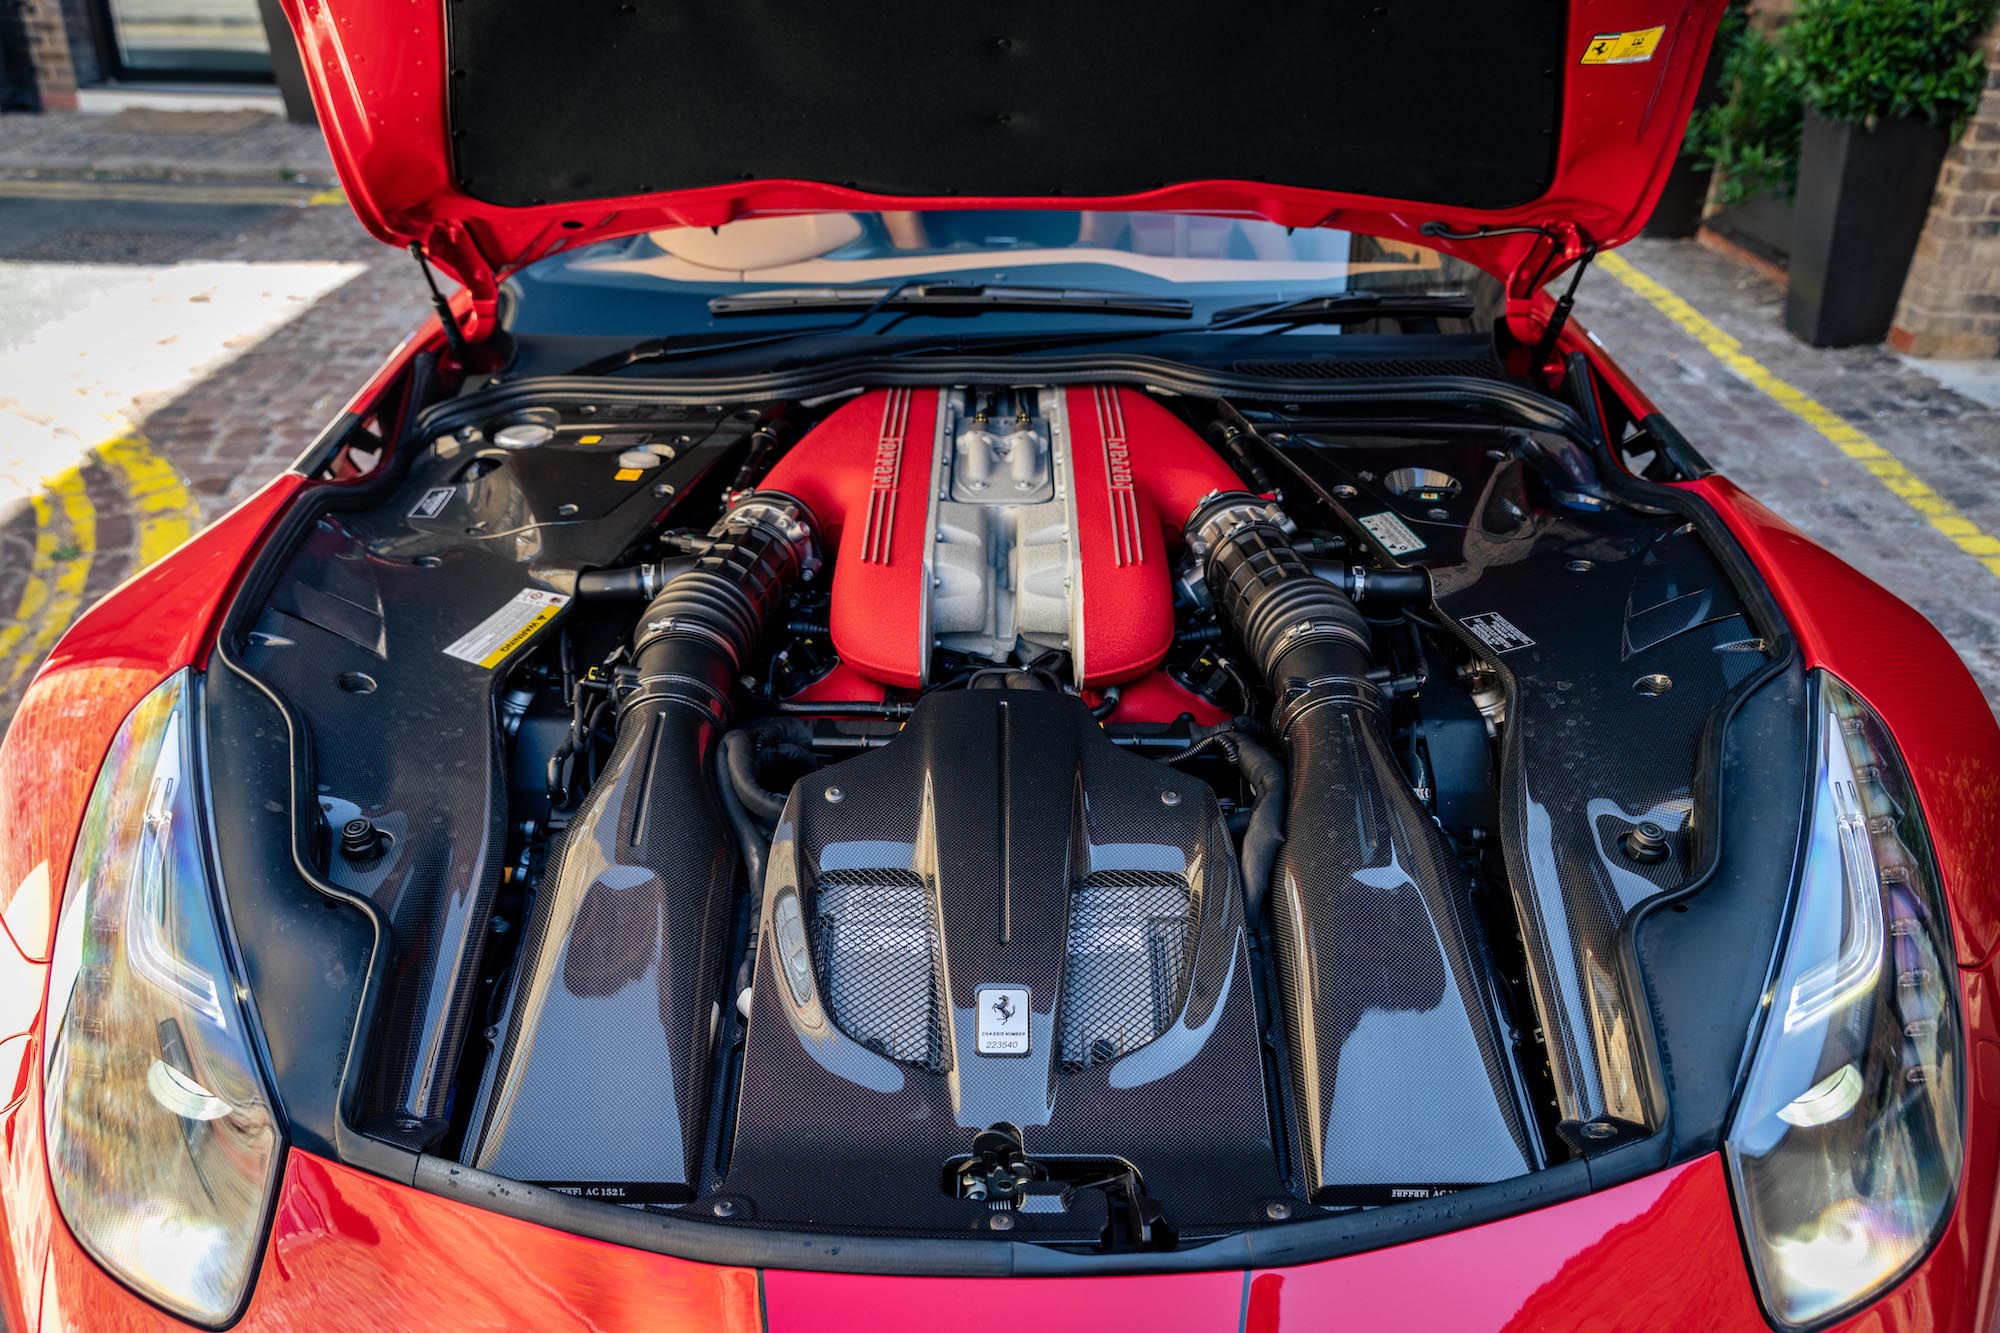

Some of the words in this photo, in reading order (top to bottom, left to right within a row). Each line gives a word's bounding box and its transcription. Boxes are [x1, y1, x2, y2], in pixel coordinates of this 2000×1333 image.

[872, 437, 903, 489] Ferrari
[1102, 437, 1133, 490] Ferrari
[500, 621, 539, 652] WARNING
[985, 1040, 1019, 1049] 223540
[585, 1187, 599, 1196] AC
[1391, 1189, 1429, 1198] Ferrari
